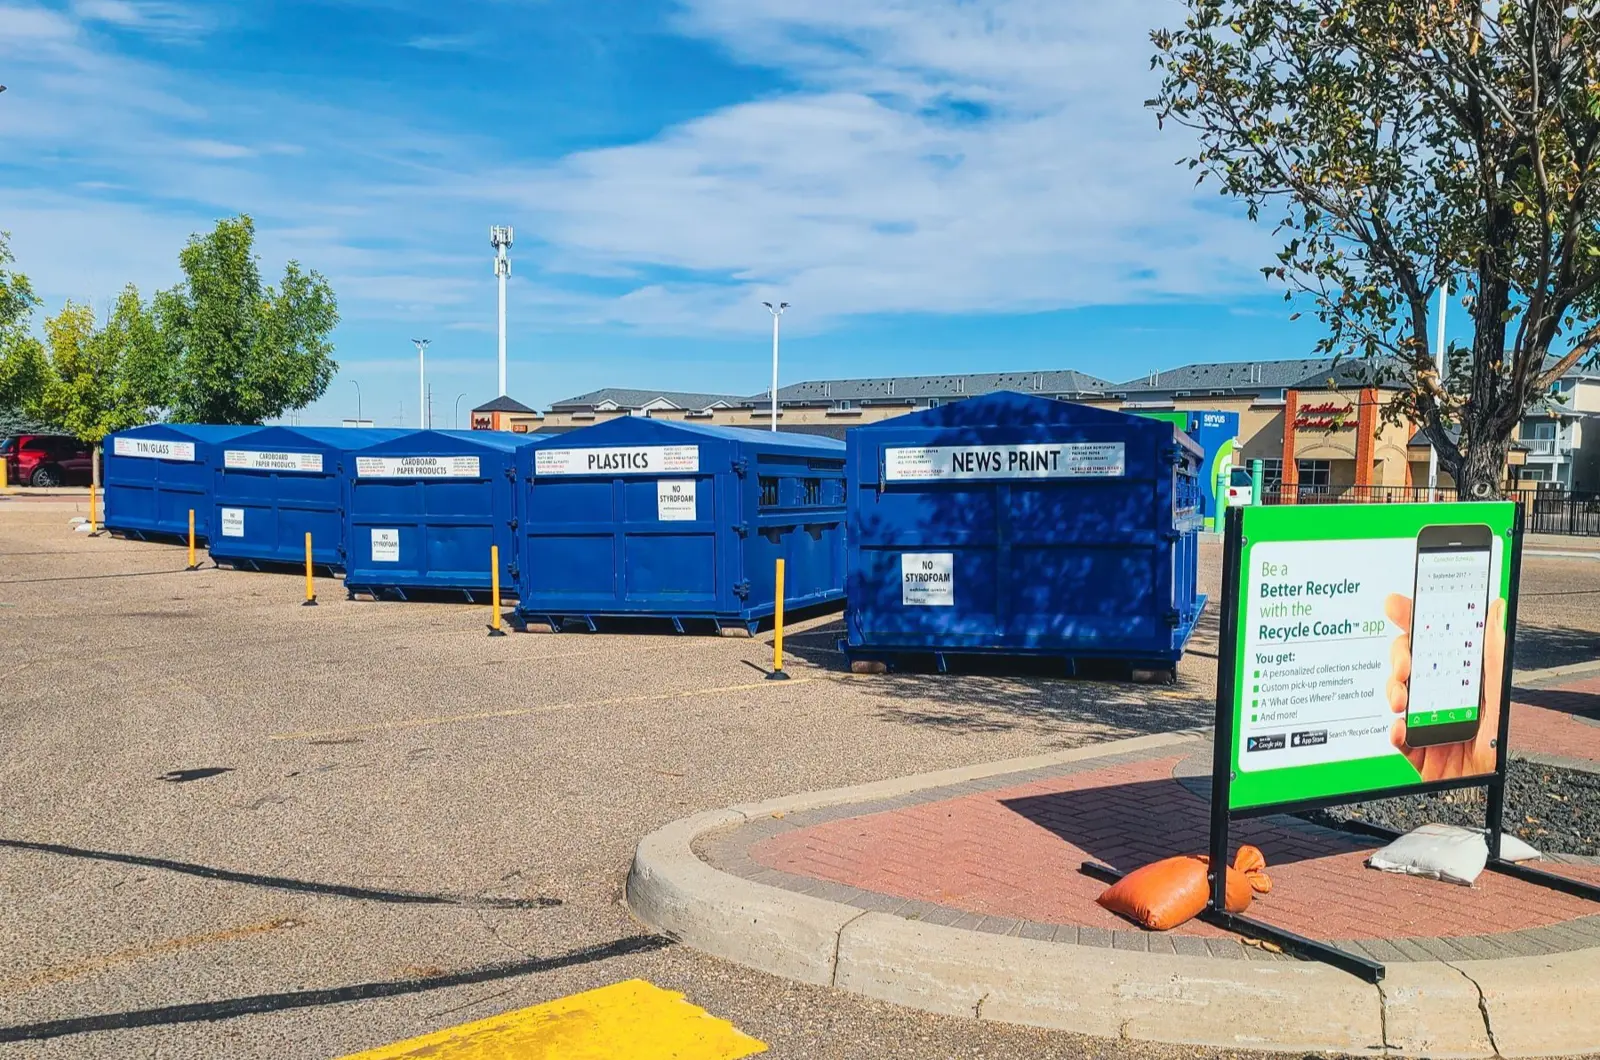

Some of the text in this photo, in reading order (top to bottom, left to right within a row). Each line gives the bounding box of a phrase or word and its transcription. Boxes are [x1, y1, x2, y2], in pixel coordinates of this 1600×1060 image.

[1203, 414, 1225, 423] servus
[136, 442, 170, 454] TIN/GLASS
[401, 458, 437, 466] CARDBOARD
[588, 452, 649, 470] PLASTICS
[952, 450, 1061, 473] NEWS PRINT
[397, 467, 414, 475] PAPER
[415, 467, 447, 475] PRODUCTS
[672, 485, 681, 493] NO
[659, 494, 694, 503] STYROFOAM
[373, 540, 398, 548] STYROFOAM
[922, 560, 933, 570] NO
[1261, 561, 1288, 577] Be a
[905, 573, 951, 583] STYROFOAM
[1260, 578, 1360, 598] Better Recycler
[1259, 601, 1313, 618] with the
[1259, 622, 1310, 642] Recycle
[1362, 619, 1385, 635] app
[1256, 651, 1296, 665] You get:
[1262, 660, 1382, 679] A personalized collection schedule
[1261, 676, 1354, 693] Custom pick-up reminders
[1260, 699, 1267, 707] A
[1290, 694, 1309, 705] Goes
[1337, 690, 1360, 700] search
[1360, 688, 1374, 699] tool
[1260, 710, 1298, 721] And more!
[1301, 736, 1325, 745] App Store
[1328, 731, 1346, 739] Search
[1258, 740, 1284, 749] Google play
